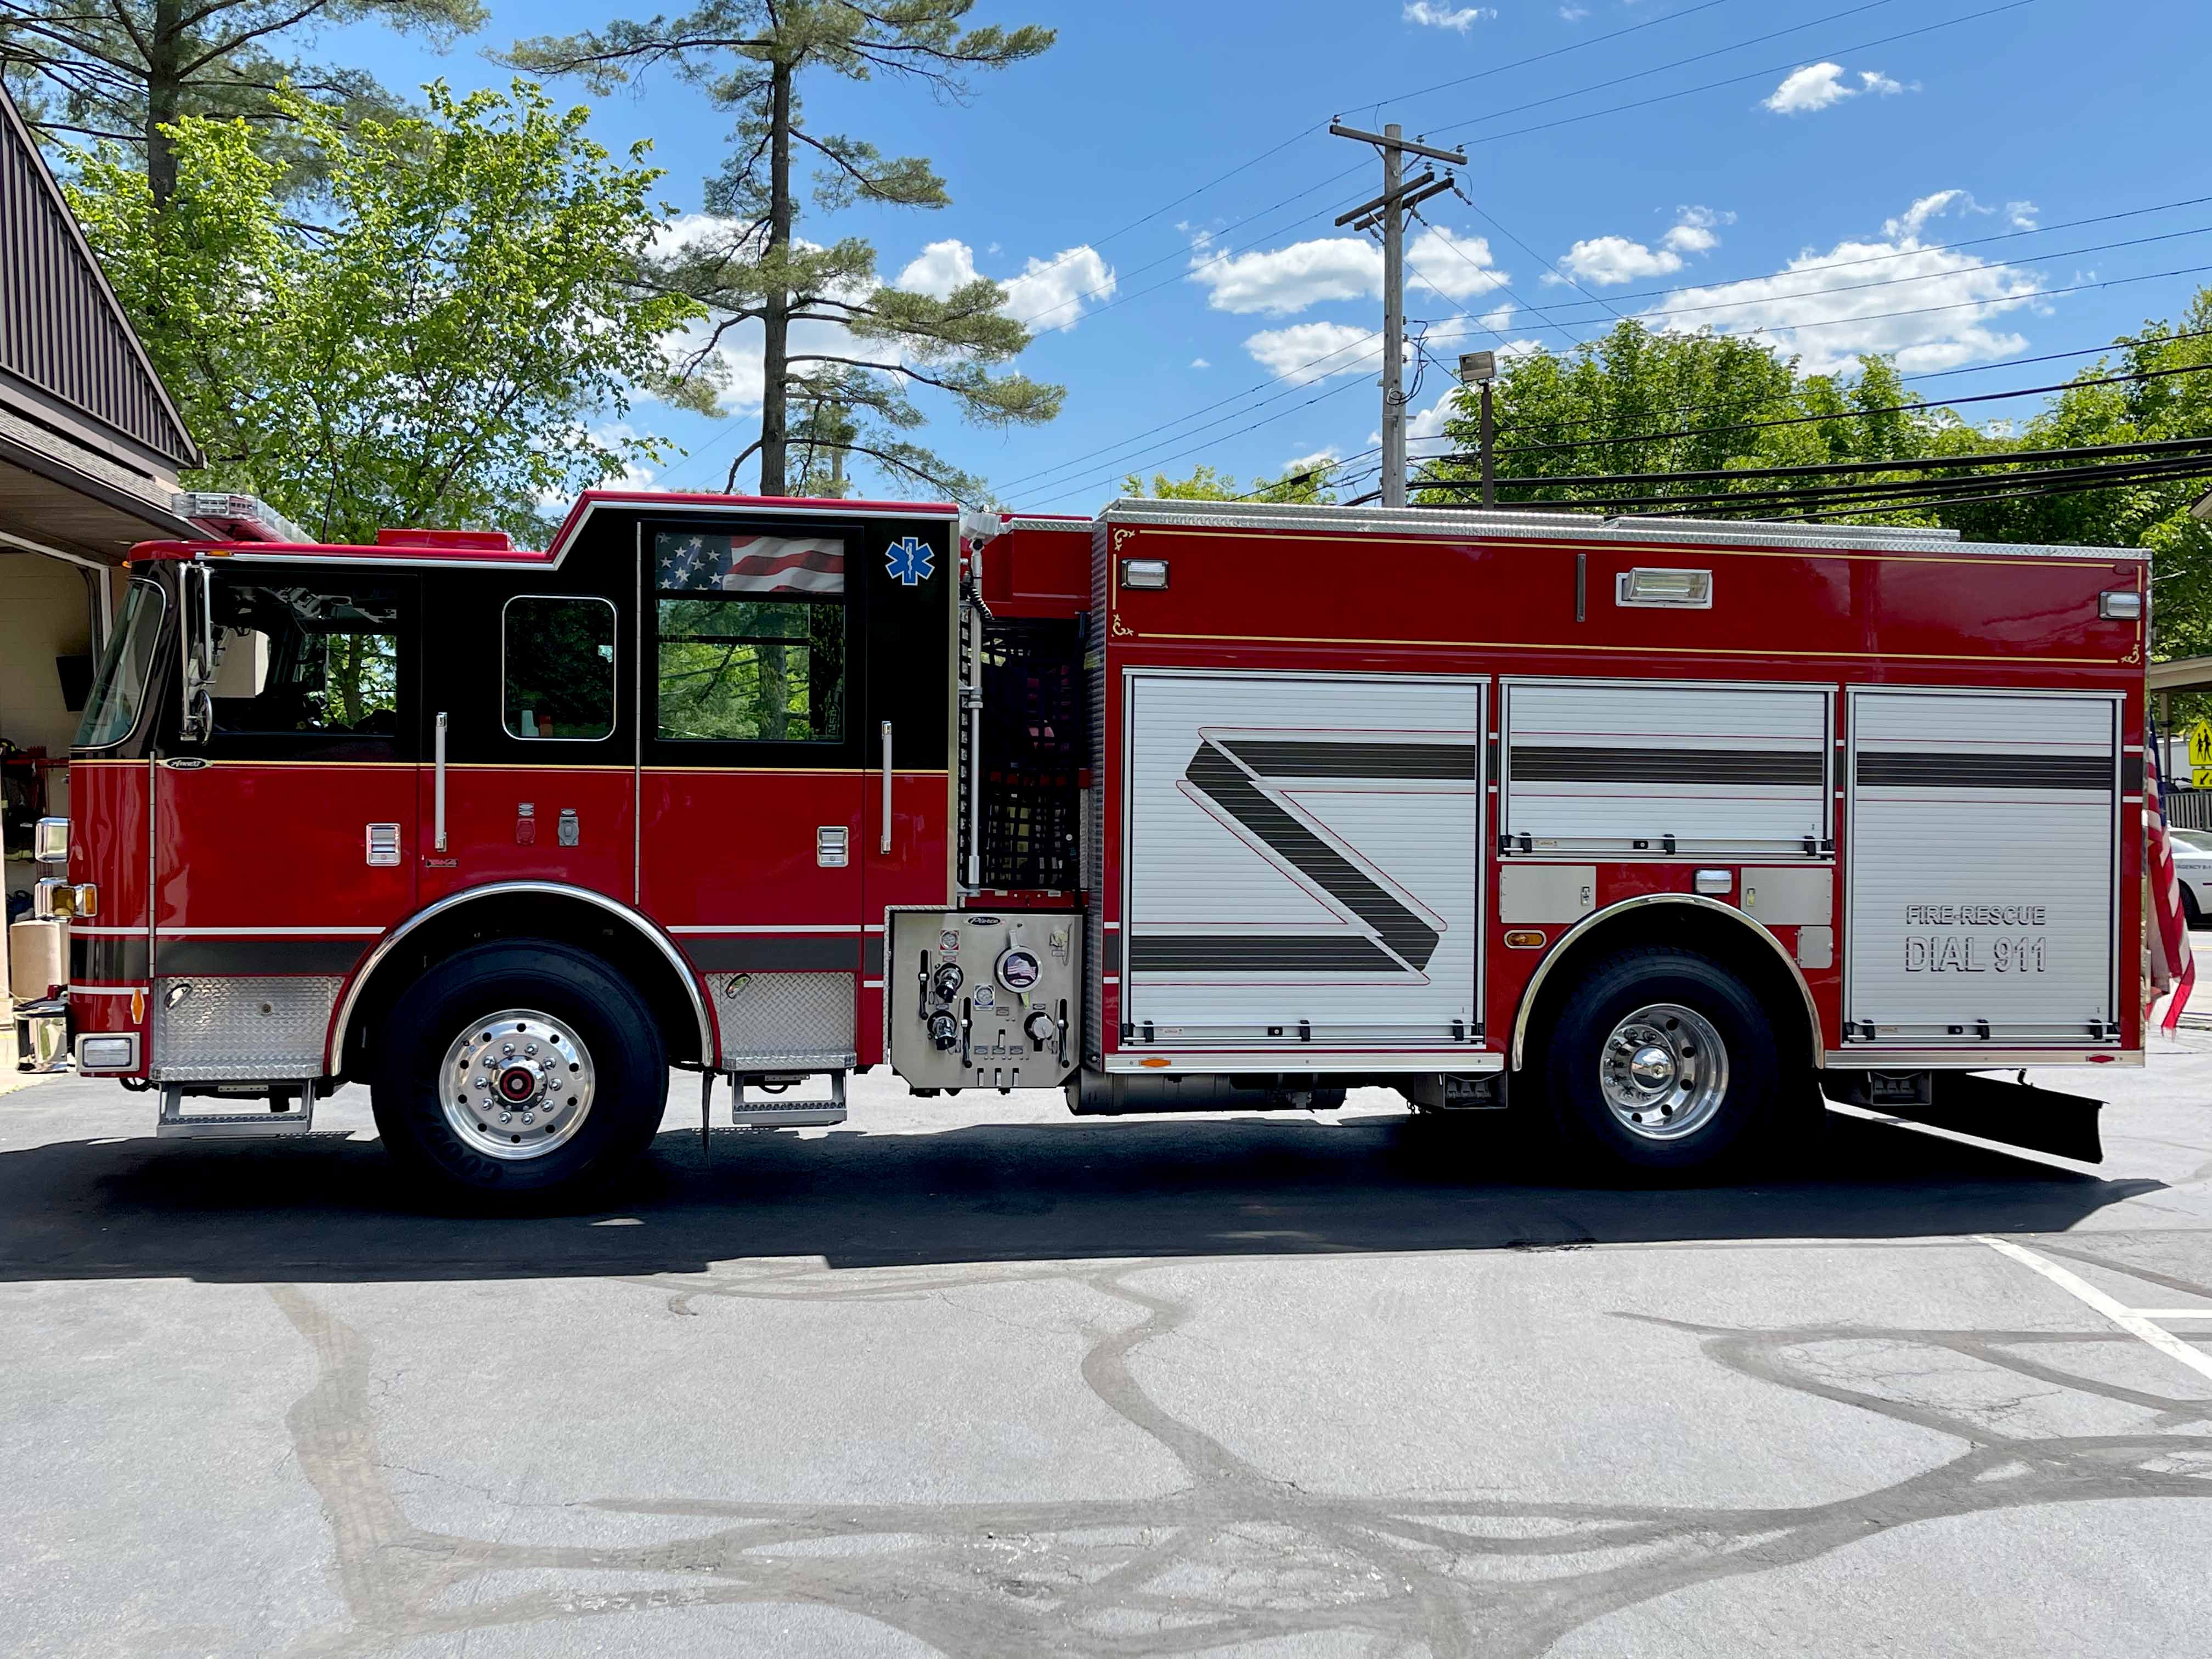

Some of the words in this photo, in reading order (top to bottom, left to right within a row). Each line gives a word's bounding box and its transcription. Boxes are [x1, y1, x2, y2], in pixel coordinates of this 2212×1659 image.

[1906, 905, 2046, 925] FIRE-RESCUE
[1905, 936, 1985, 972] DIAL
[1994, 936, 2046, 973] 911
